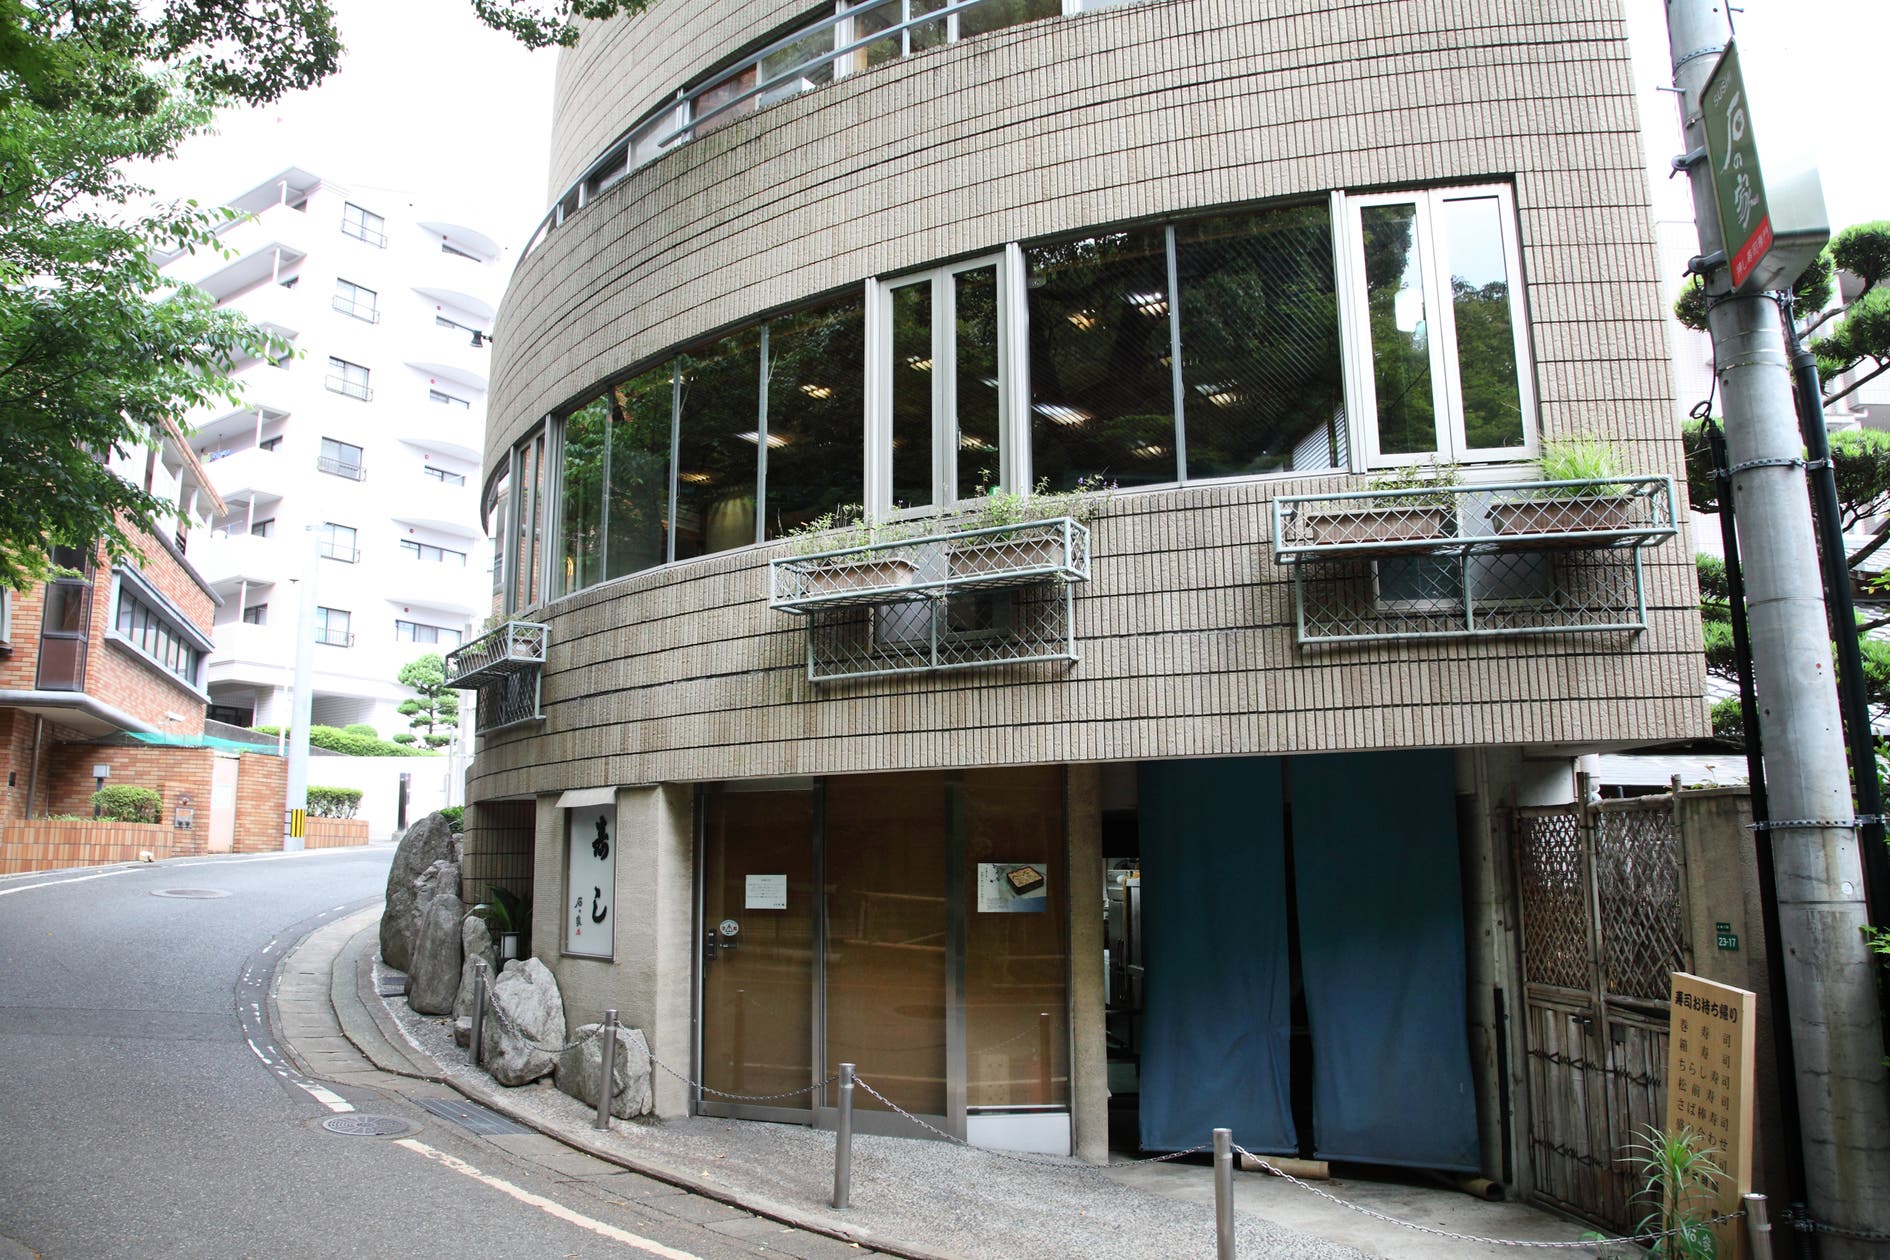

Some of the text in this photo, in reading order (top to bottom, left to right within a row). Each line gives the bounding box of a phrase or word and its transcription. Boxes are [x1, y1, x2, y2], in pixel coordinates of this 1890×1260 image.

[1720, 91, 1759, 231] 石の家
[1718, 937, 1736, 947] 23-17
[1675, 991, 1737, 1023] 寿司お持ち帰り
[1679, 1057, 1730, 1090] ちらし寿司
[1678, 1077, 1730, 1111] 松前寿司
